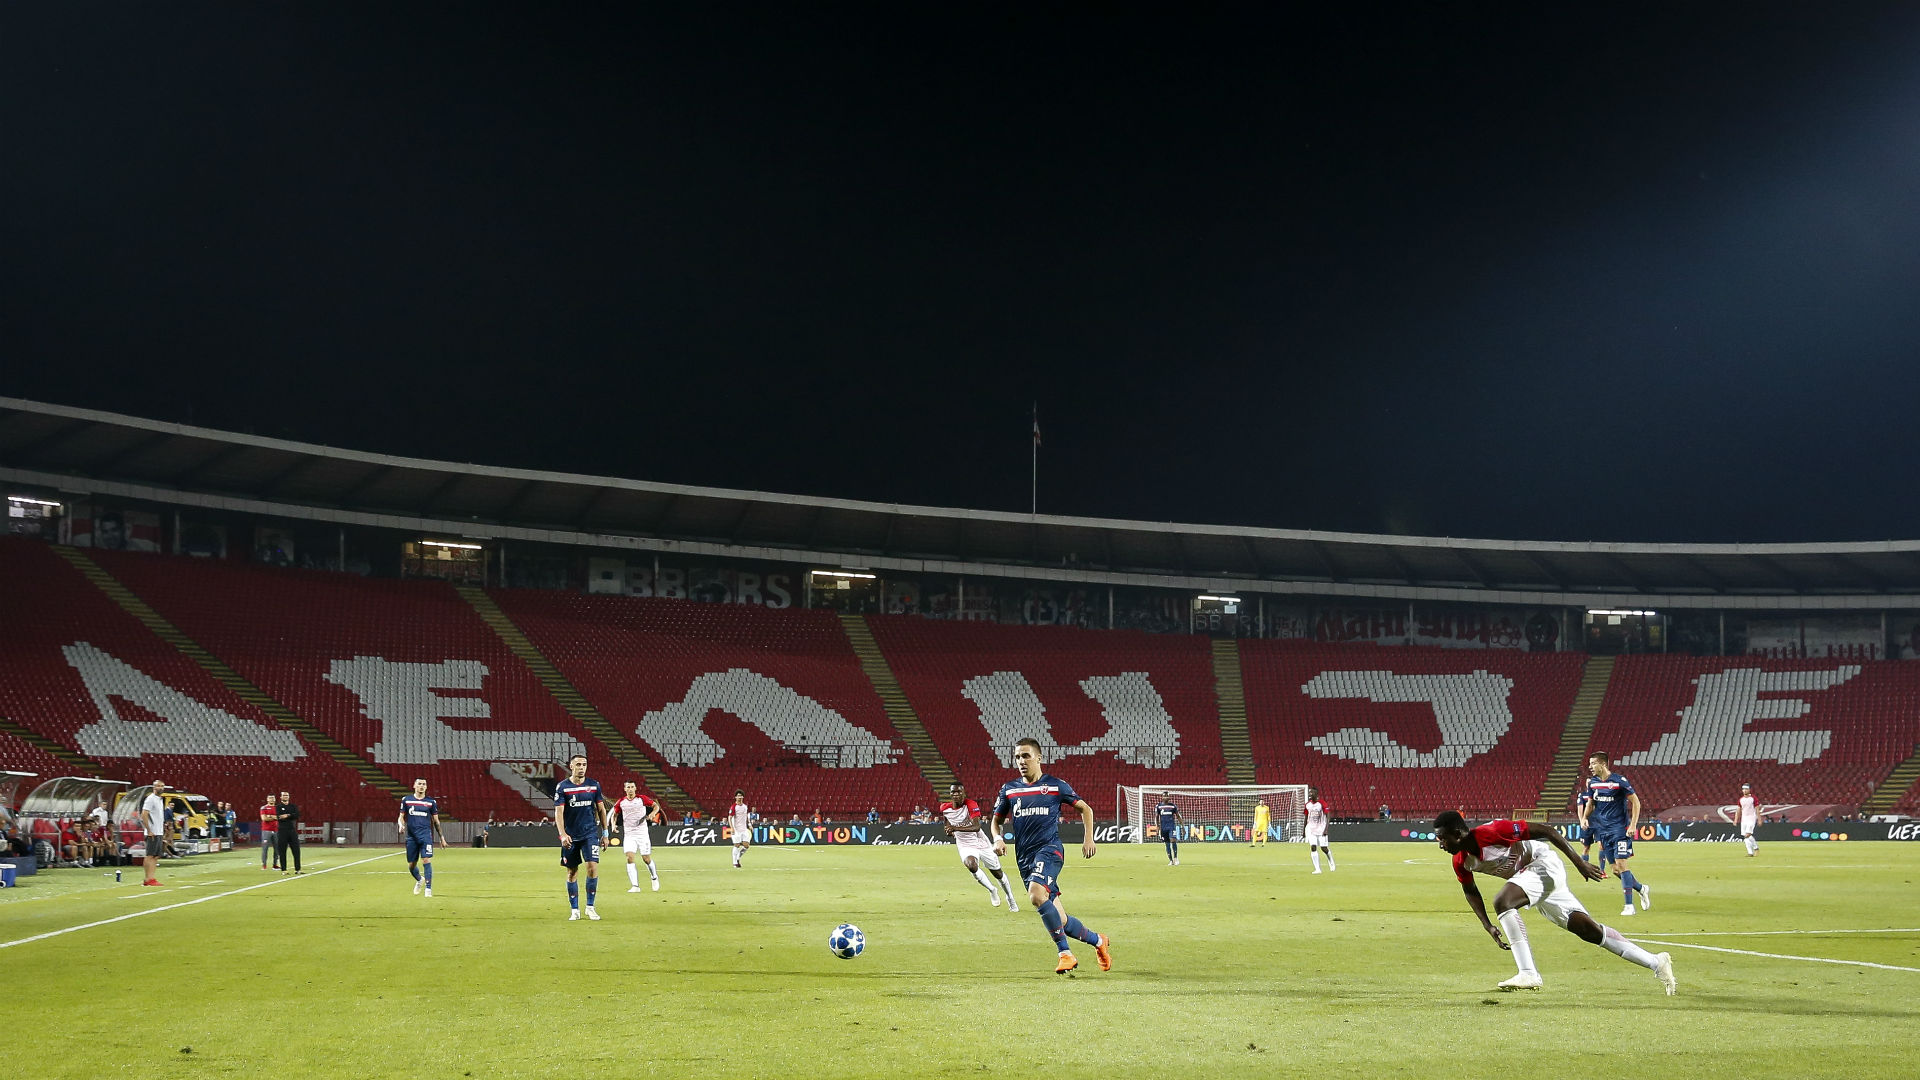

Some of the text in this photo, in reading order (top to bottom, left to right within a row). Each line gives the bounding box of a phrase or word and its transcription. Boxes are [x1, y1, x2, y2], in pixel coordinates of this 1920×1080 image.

[510, 762, 555, 779] ВЕЗДА
[1020, 806, 1049, 817] GAZPROM
[665, 828, 718, 844] UEFA
[722, 825, 867, 844] FUNDATION
[1093, 825, 1140, 841] UEFA
[1035, 861, 1045, 874] 9
